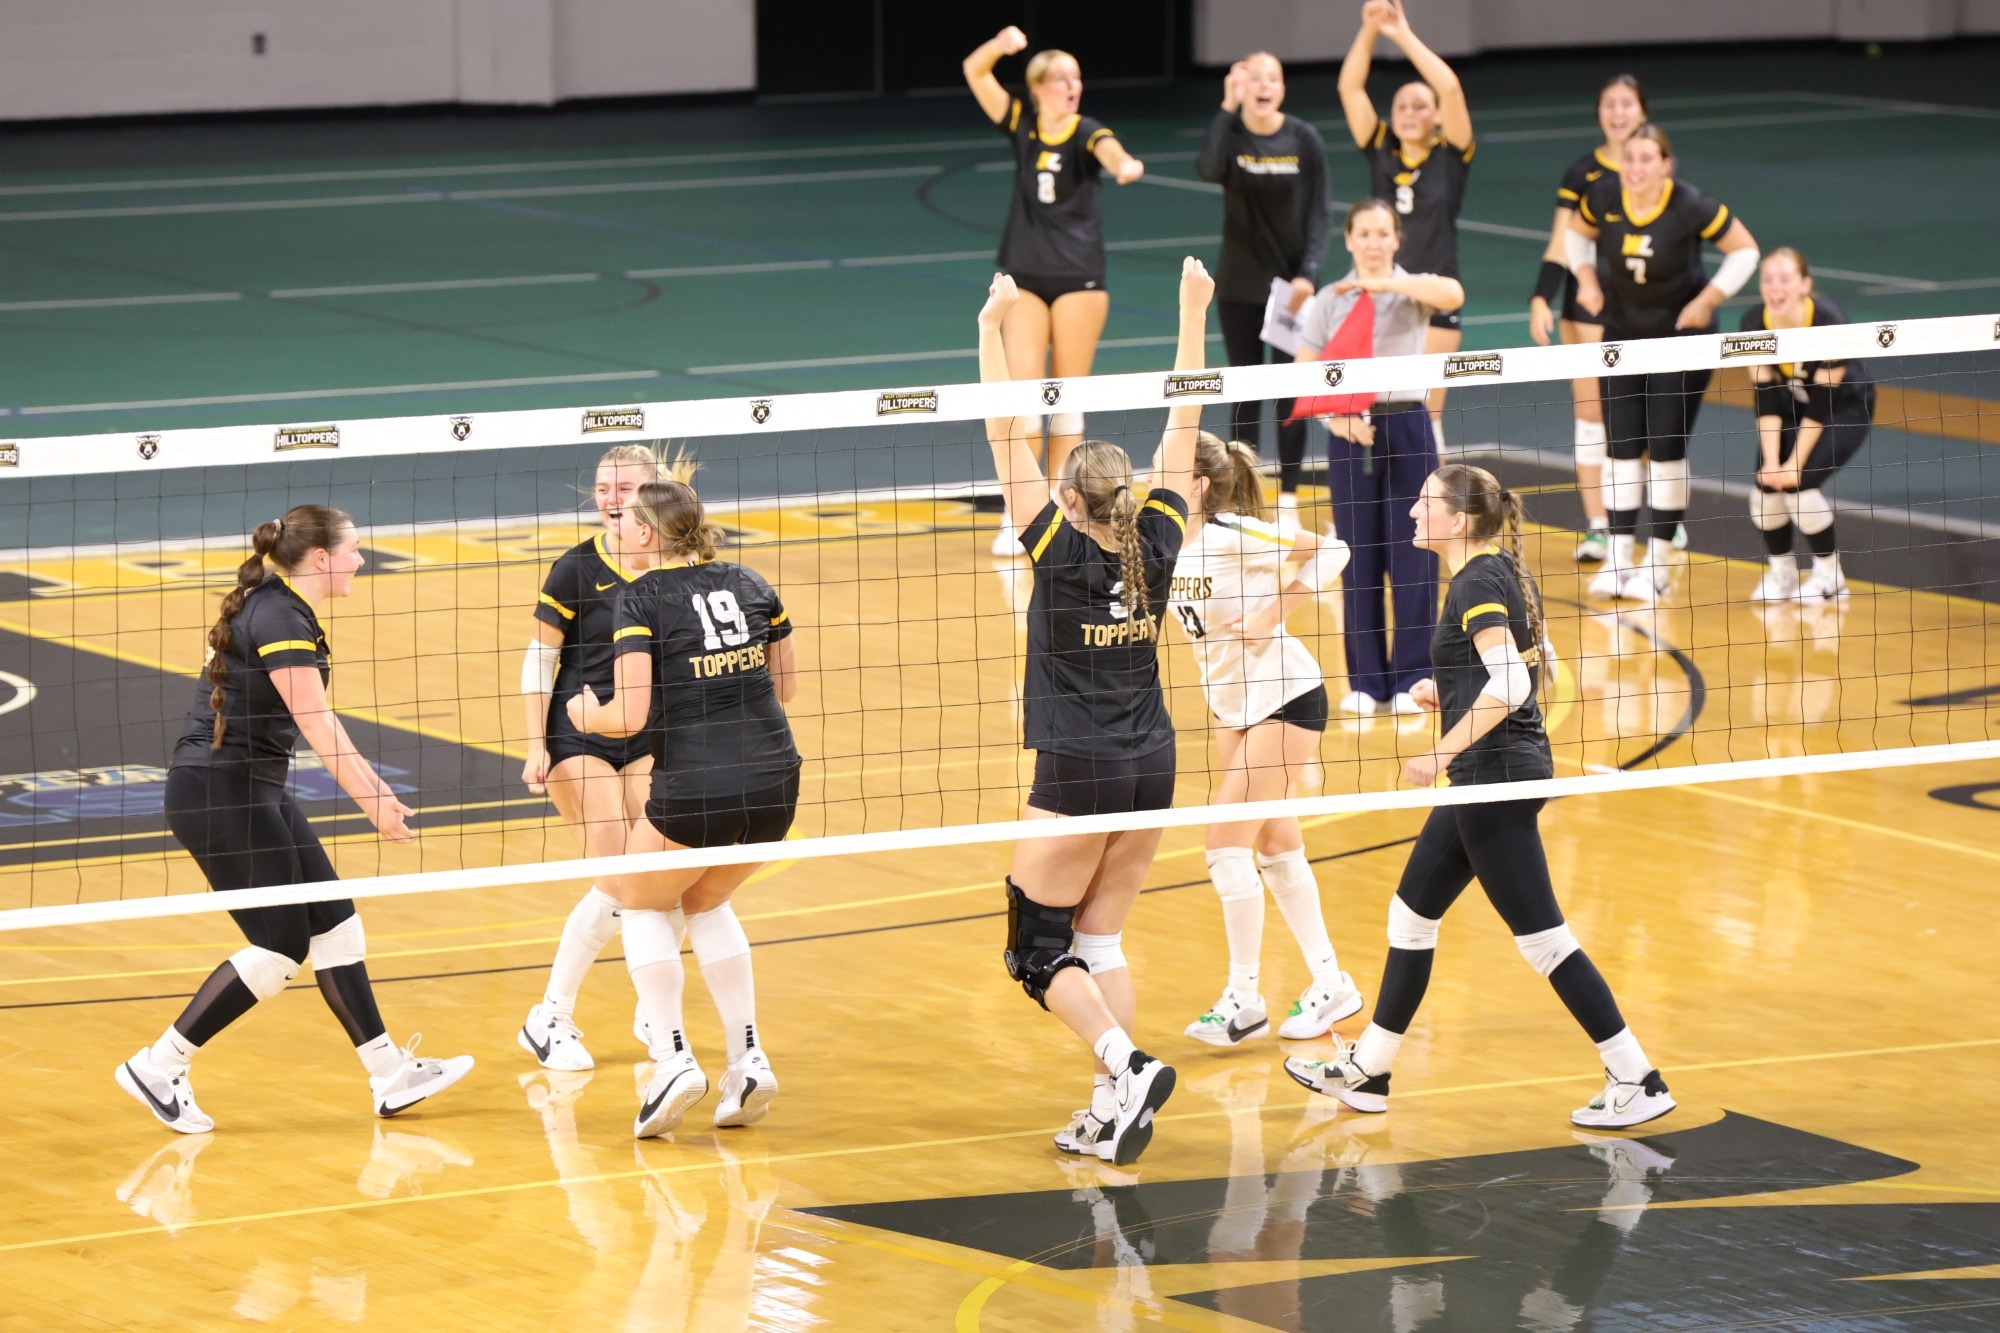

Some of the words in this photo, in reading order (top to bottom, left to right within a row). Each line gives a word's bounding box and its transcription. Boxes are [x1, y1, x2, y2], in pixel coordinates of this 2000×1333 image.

[1395, 185, 1414, 214] 9
[1625, 257, 1647, 284] 7
[1722, 339, 1776, 355] HILLTOPPERS
[1445, 359, 1501, 375] HILLTOPPERS
[1166, 379, 1222, 394] HILLTOPPERS
[879, 397, 936, 412] HILLTOPPERS
[583, 414, 643, 430] HILLTOPPERS
[276, 431, 338, 448] HILLTOPPERS
[692, 590, 750, 650] 19
[689, 643, 766, 679] TOPPERS
